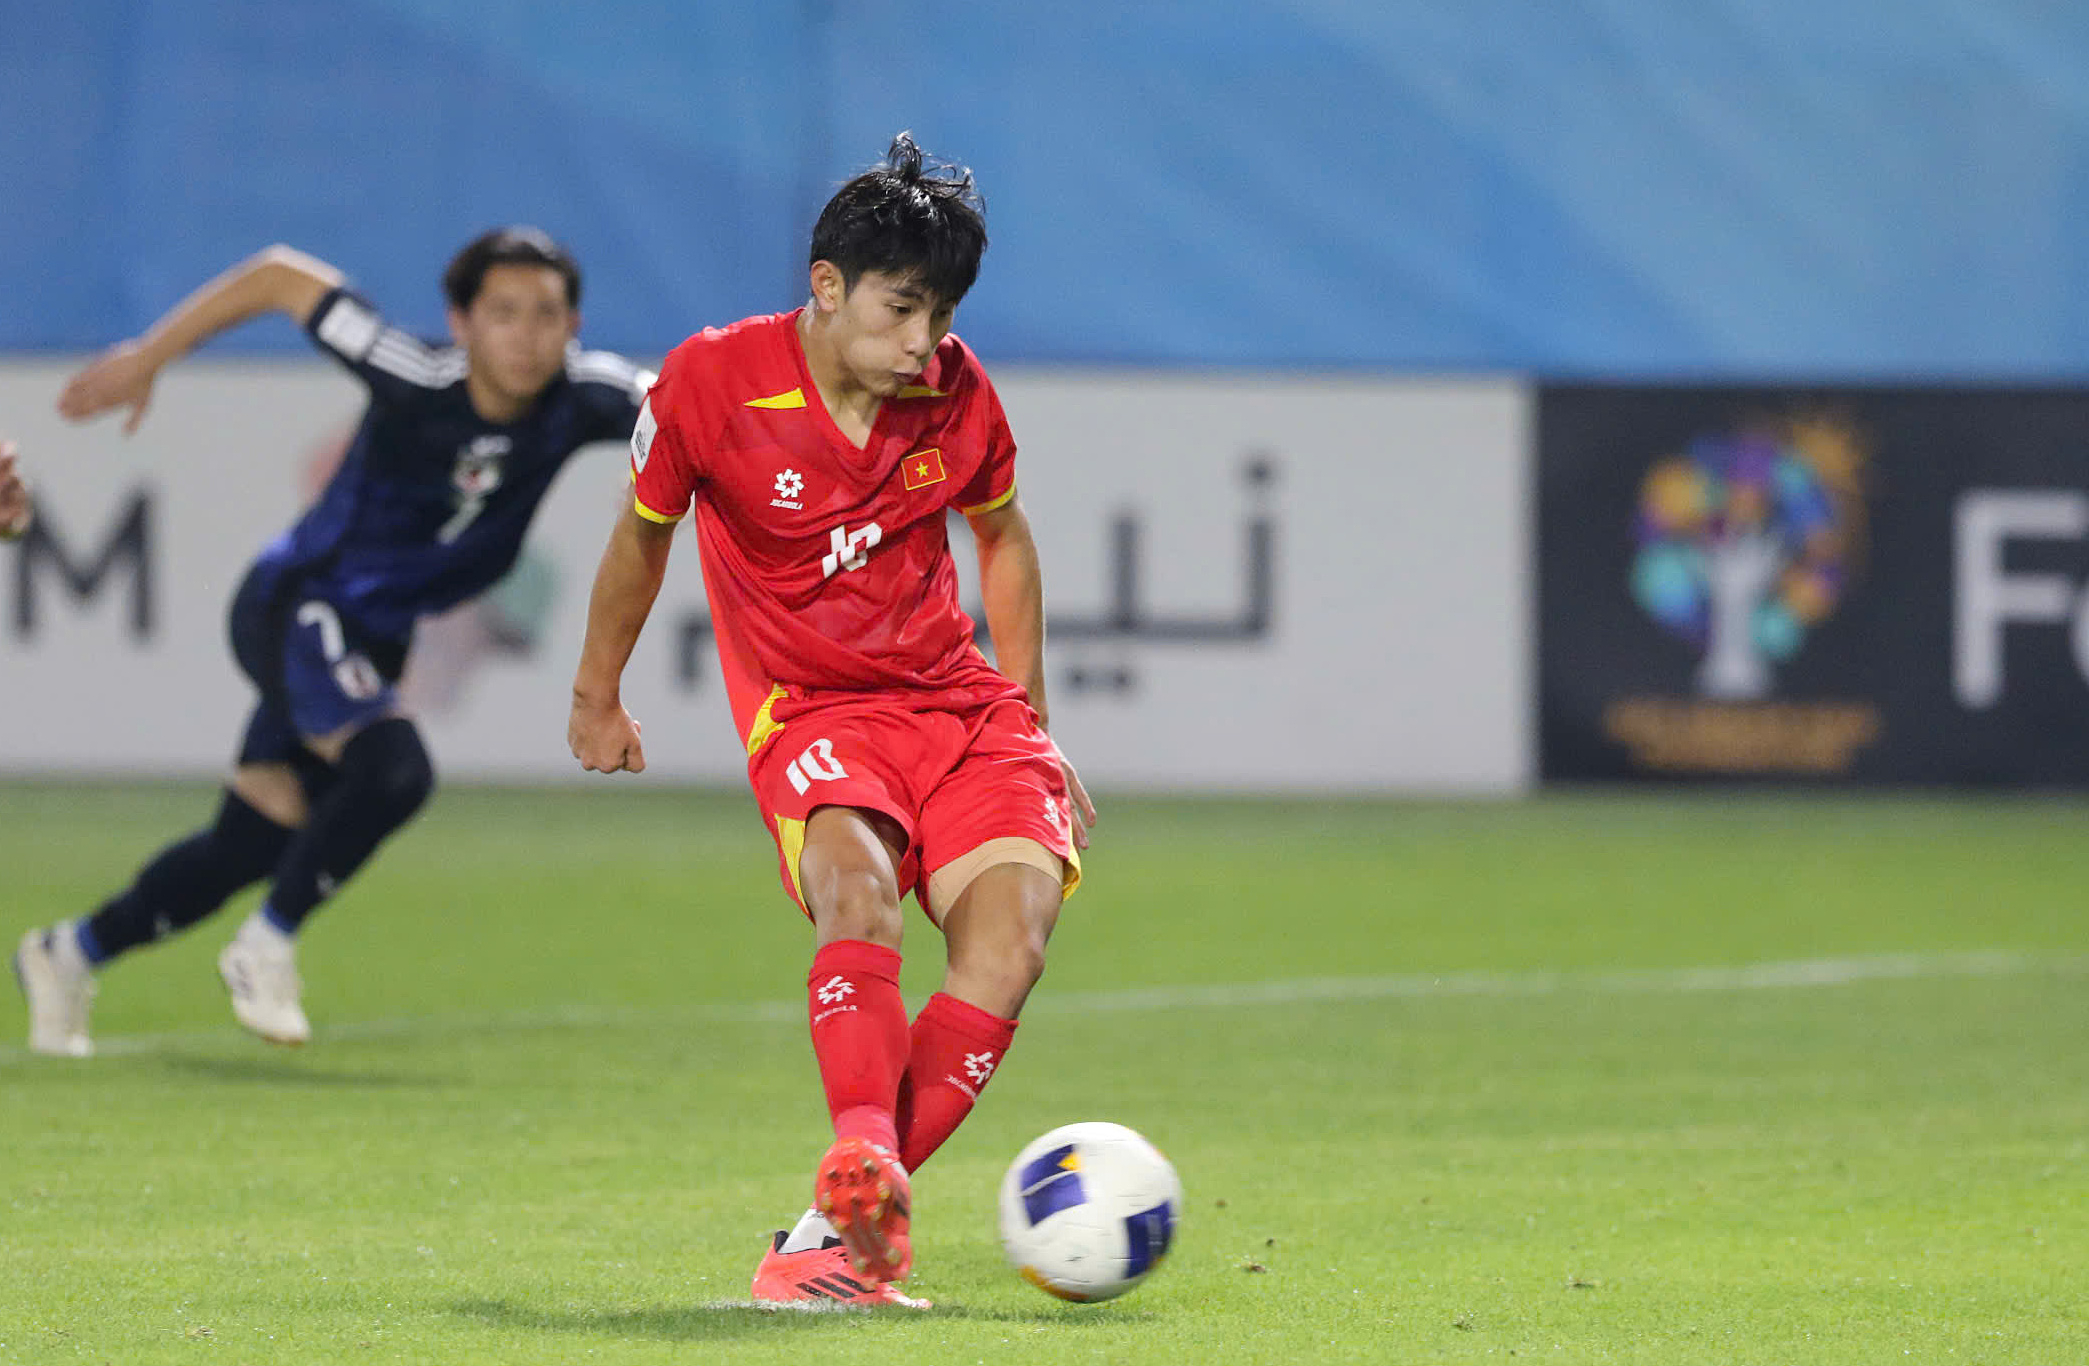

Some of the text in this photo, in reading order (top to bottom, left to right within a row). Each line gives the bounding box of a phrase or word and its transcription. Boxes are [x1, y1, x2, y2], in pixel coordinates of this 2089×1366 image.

[16, 487, 156, 640] M
[821, 521, 883, 579] 10
[1953, 488, 2089, 708] F
[296, 600, 347, 663] 7
[785, 737, 850, 797] 10
